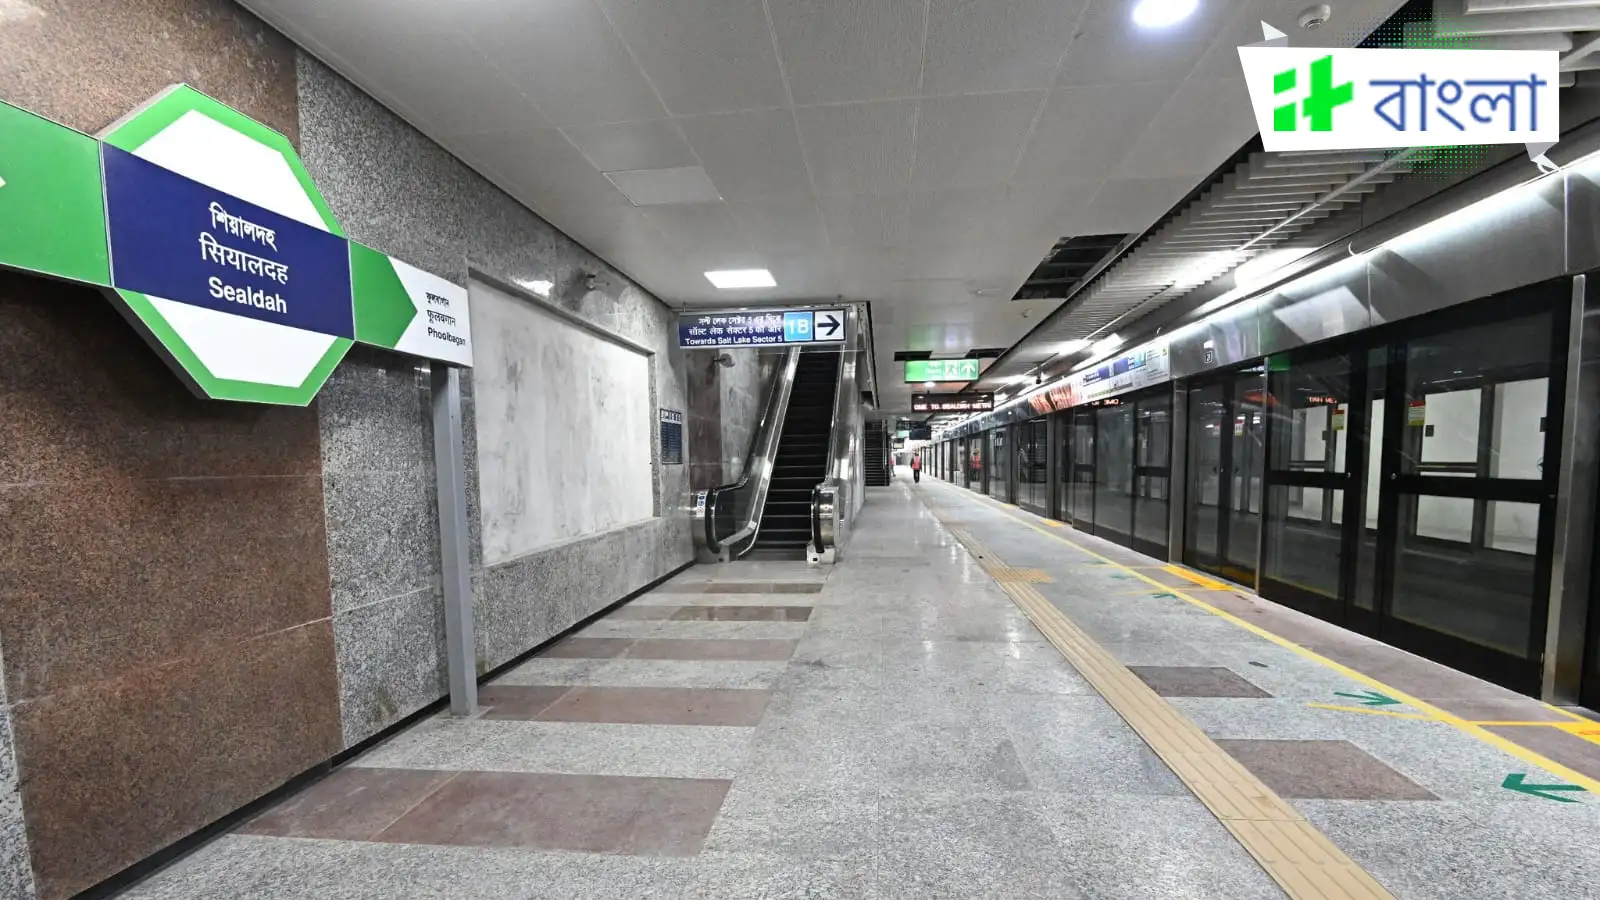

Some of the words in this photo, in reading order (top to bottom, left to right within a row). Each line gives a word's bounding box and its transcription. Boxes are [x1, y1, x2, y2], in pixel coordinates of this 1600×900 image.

[208, 201, 278, 253] শিয়ালদহ
[198, 231, 289, 285] सियालदह
[208, 276, 288, 314] Sealdah
[427, 327, 467, 346] Phoolbagan
[685, 337, 717, 346] Towards
[717, 336, 732, 345] Salt
[733, 336, 751, 344] Lake
[752, 335, 776, 344] Sector
[777, 335, 783, 343] 5
[708, 326, 724, 335] लेक
